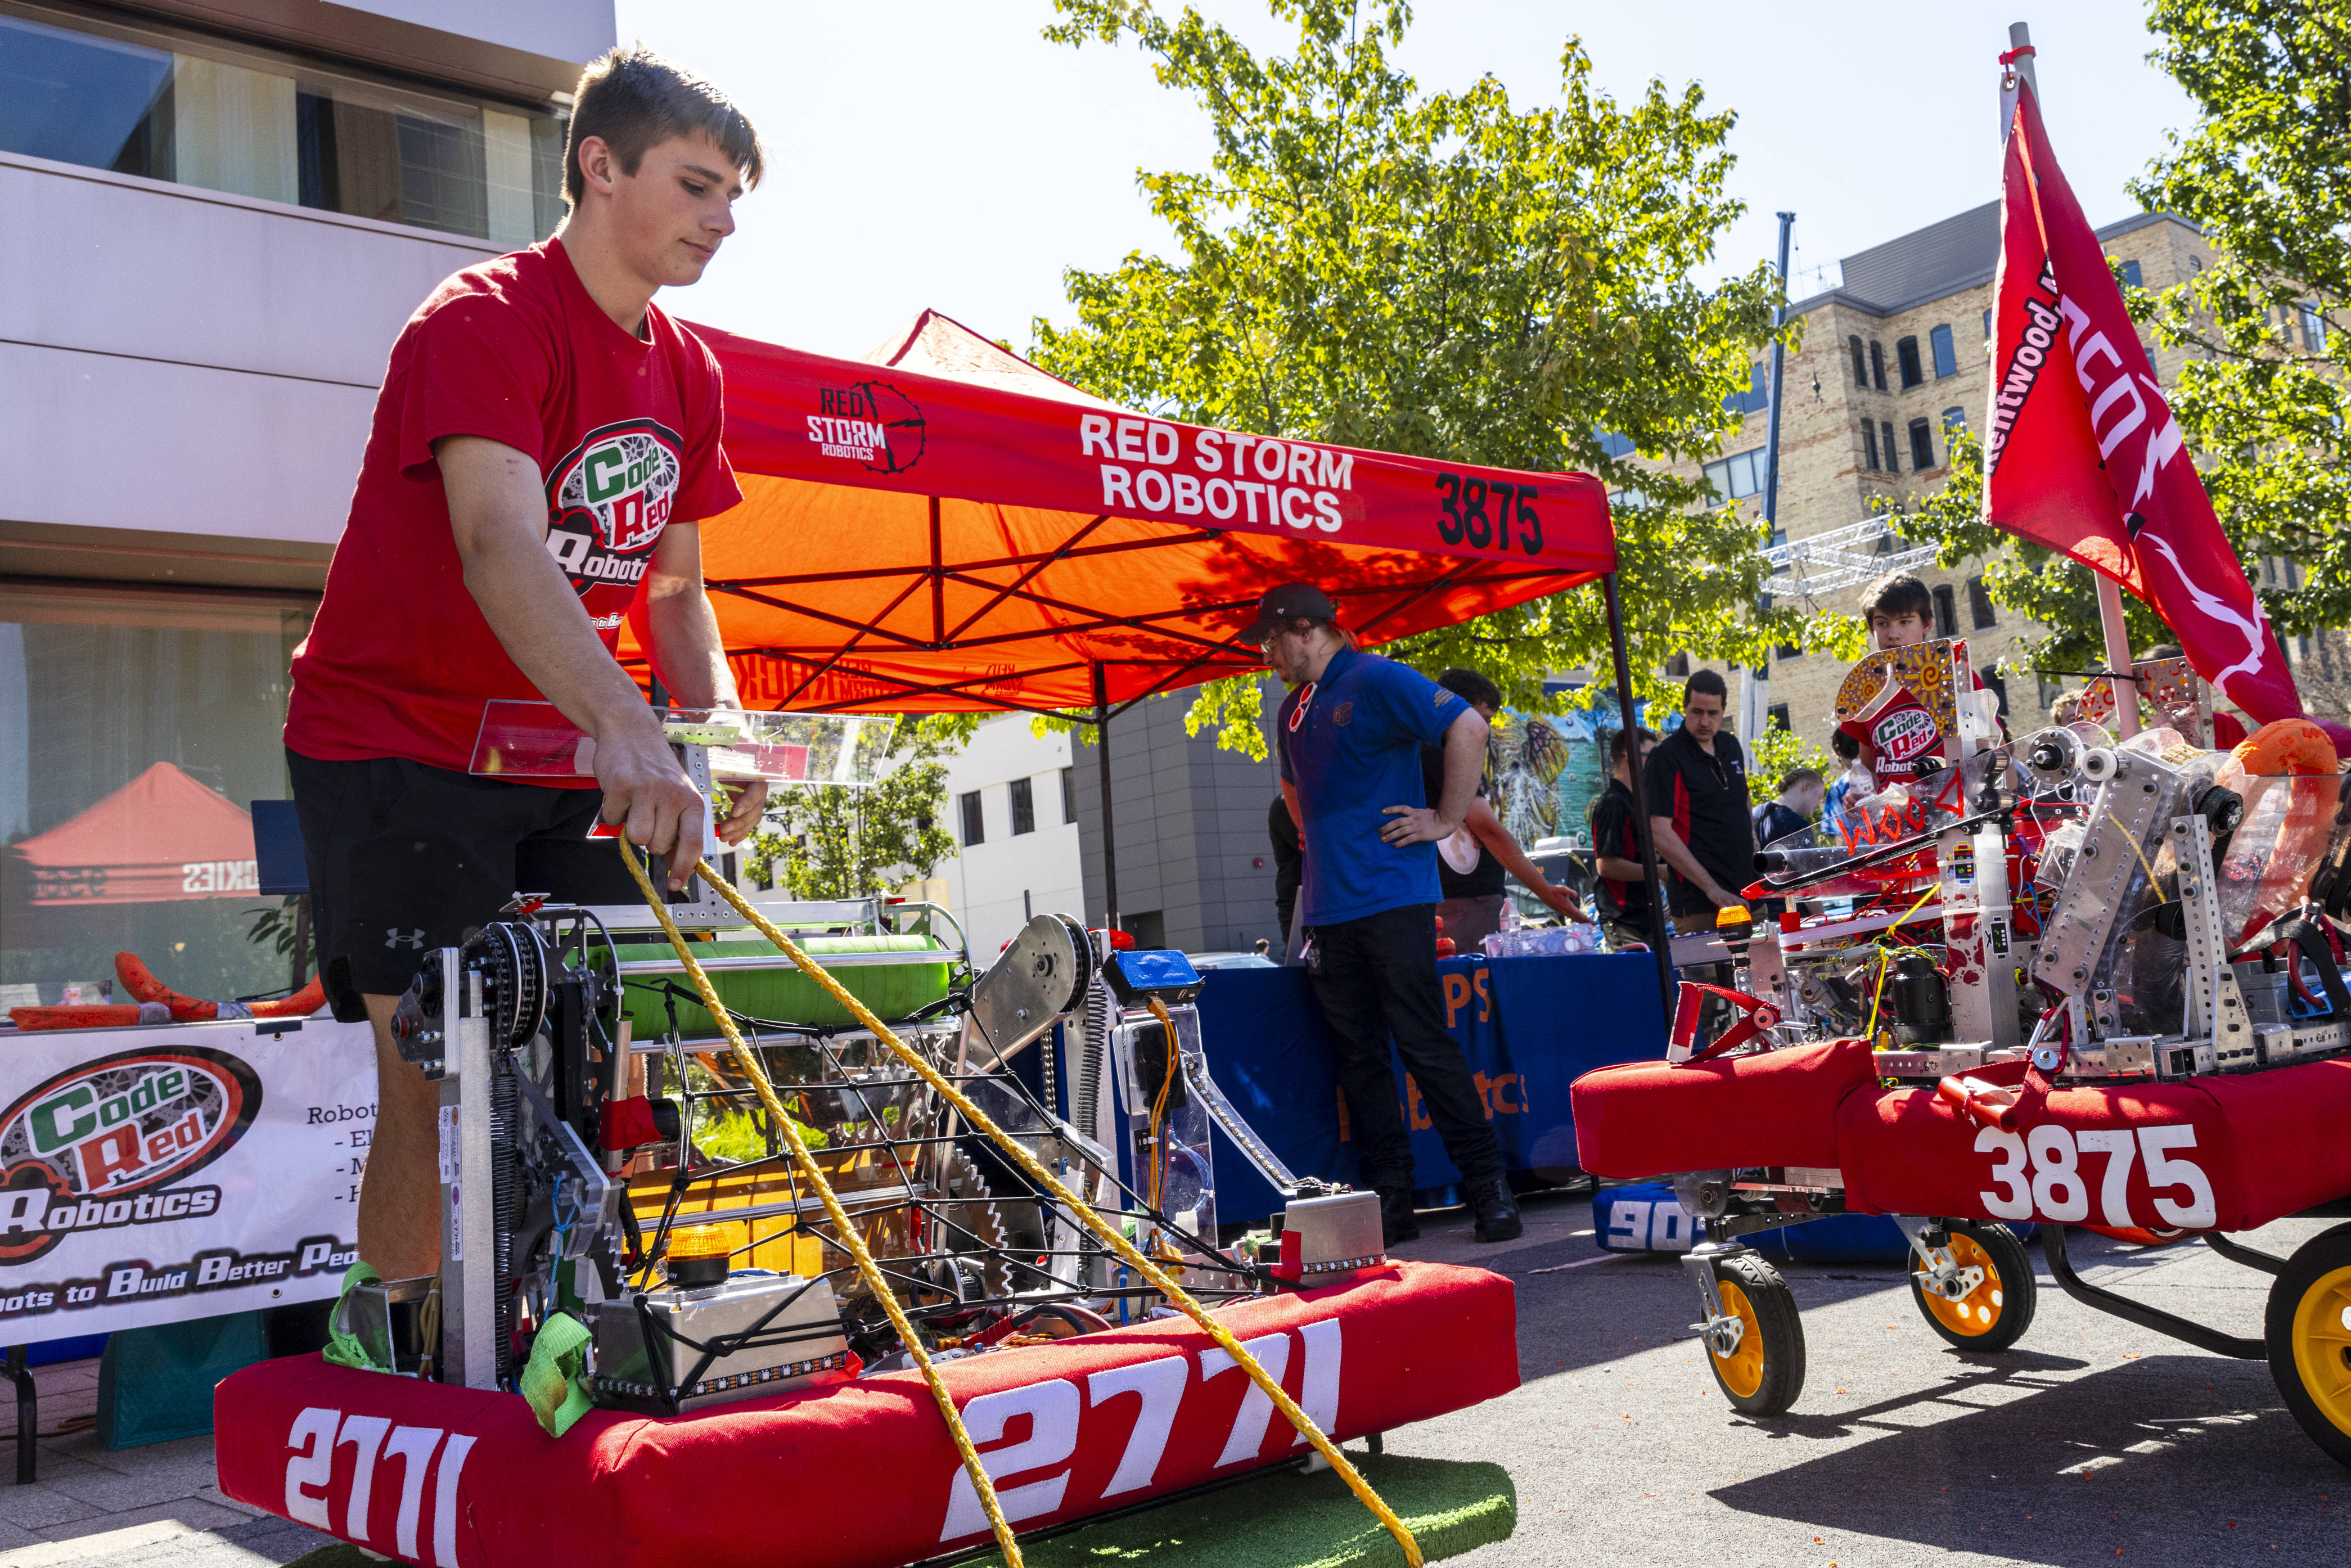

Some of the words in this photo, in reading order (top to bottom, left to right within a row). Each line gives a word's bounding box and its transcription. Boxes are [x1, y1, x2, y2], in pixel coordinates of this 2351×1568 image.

[821, 388, 864, 417] RED
[807, 416, 886, 449] STORM
[821, 443, 874, 461] ROBOTICS
[1080, 414, 1179, 466] RED
[1195, 431, 1354, 490] STORM
[584, 446, 660, 503] Code
[1100, 464, 1343, 533] ROBOTICS
[612, 489, 670, 548] Red
[1435, 473, 1544, 556] 3875
[1878, 713, 1921, 744] Code
[1891, 730, 1928, 759] Red
[30, 1070, 184, 1154] Code
[78, 1112, 204, 1192] Red
[1974, 1124, 2217, 1228] 3875
[0, 1188, 217, 1235] Robotics
[66, 1286, 97, 1303] to
[107, 1268, 187, 1297] Build
[197, 1256, 290, 1286] Better
[939, 1318, 1343, 1542] 2771
[285, 1407, 478, 1568] 2771
